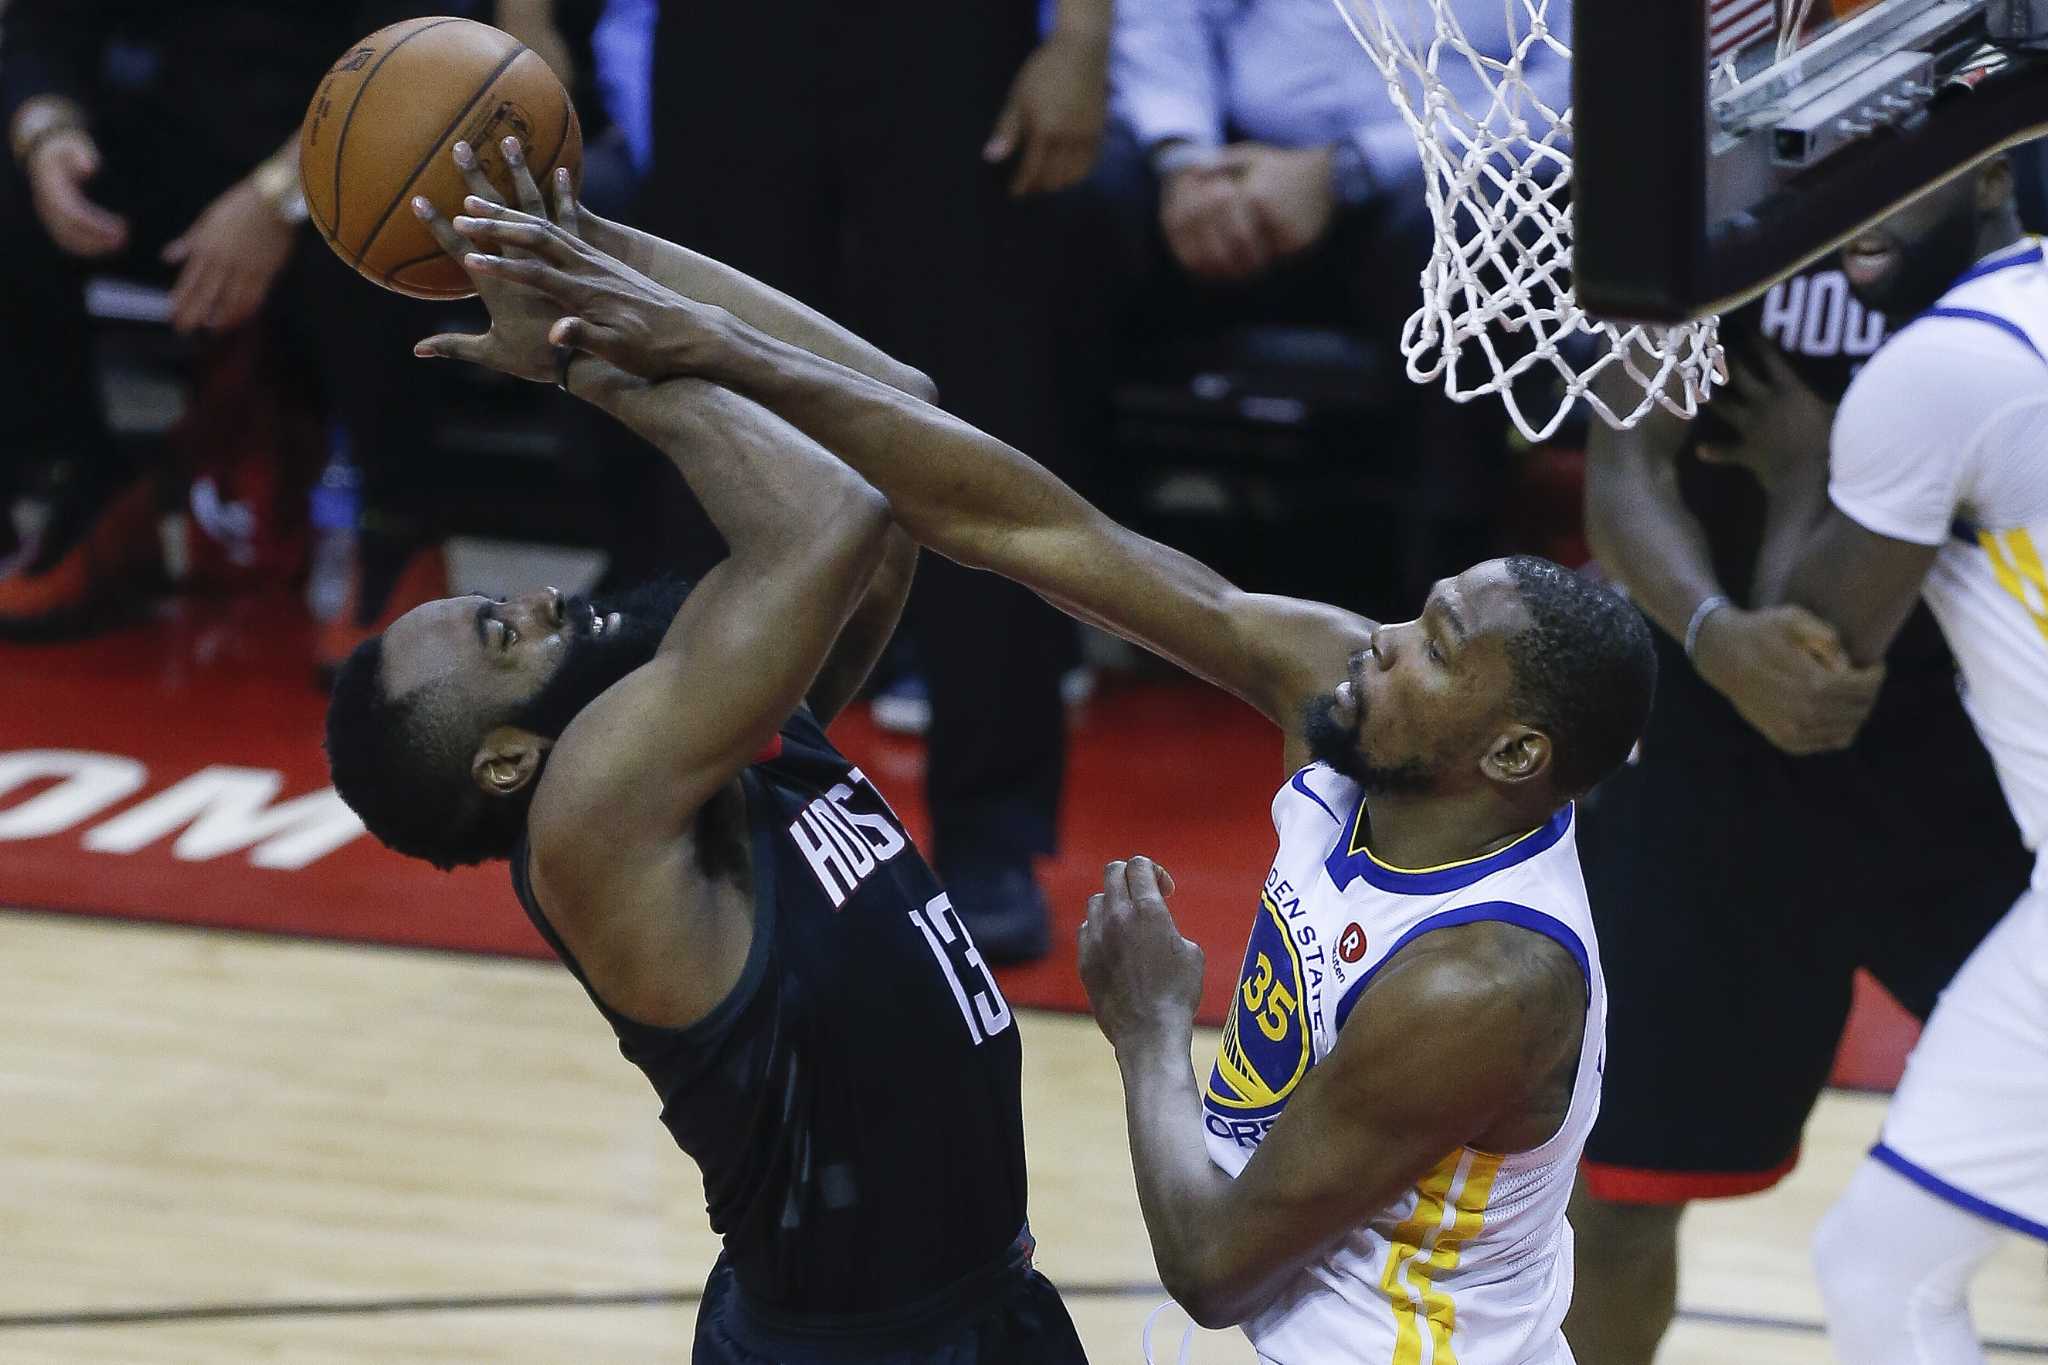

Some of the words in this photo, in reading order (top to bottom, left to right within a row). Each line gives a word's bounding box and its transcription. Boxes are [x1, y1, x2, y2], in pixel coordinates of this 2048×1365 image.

[908, 891, 1011, 1046] 13
[1242, 952, 1297, 1042] 35
[1333, 936, 1346, 984] kuten
